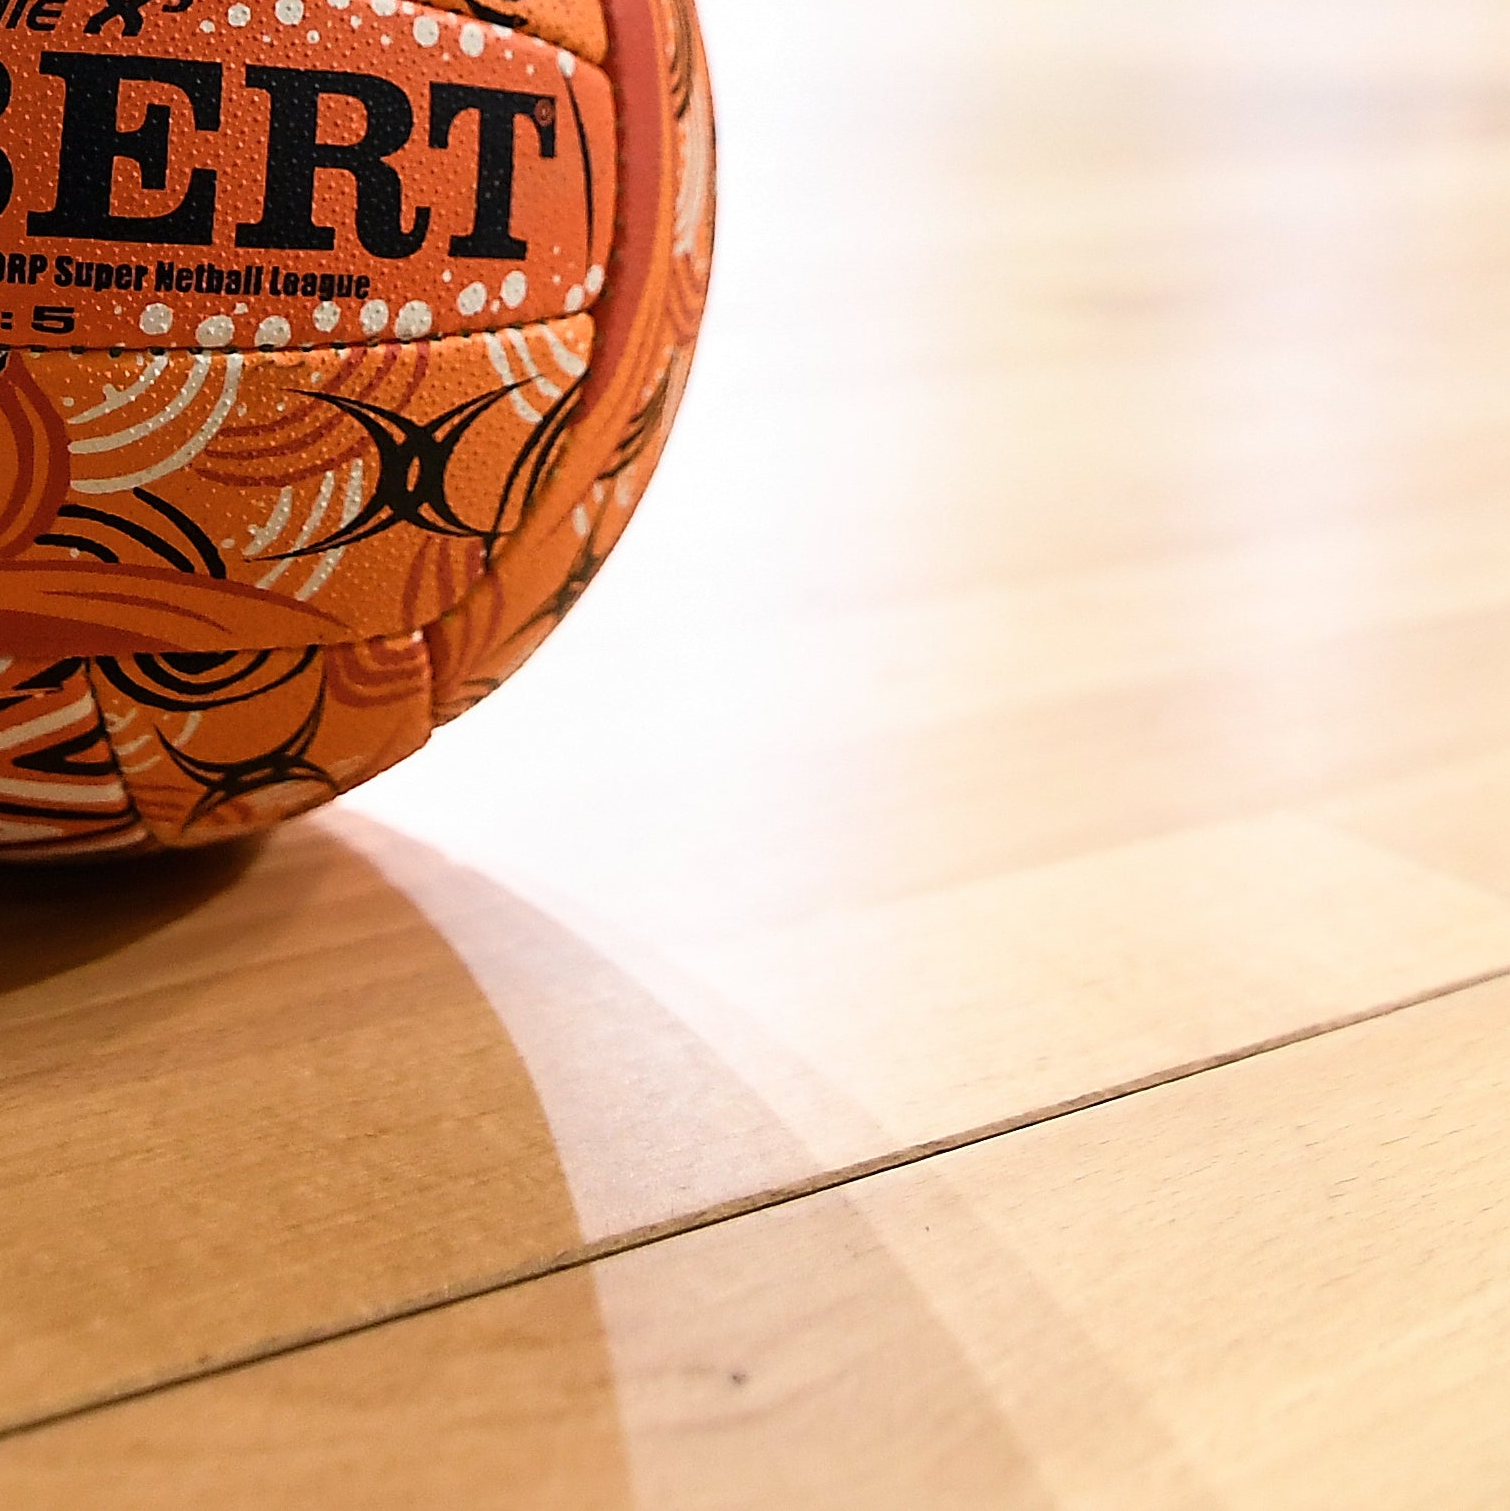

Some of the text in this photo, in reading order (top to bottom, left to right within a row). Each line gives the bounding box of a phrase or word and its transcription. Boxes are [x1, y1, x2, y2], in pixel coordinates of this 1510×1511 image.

[54, 256, 149, 292] Super
[154, 261, 264, 295] Netball
[270, 265, 371, 301] League
